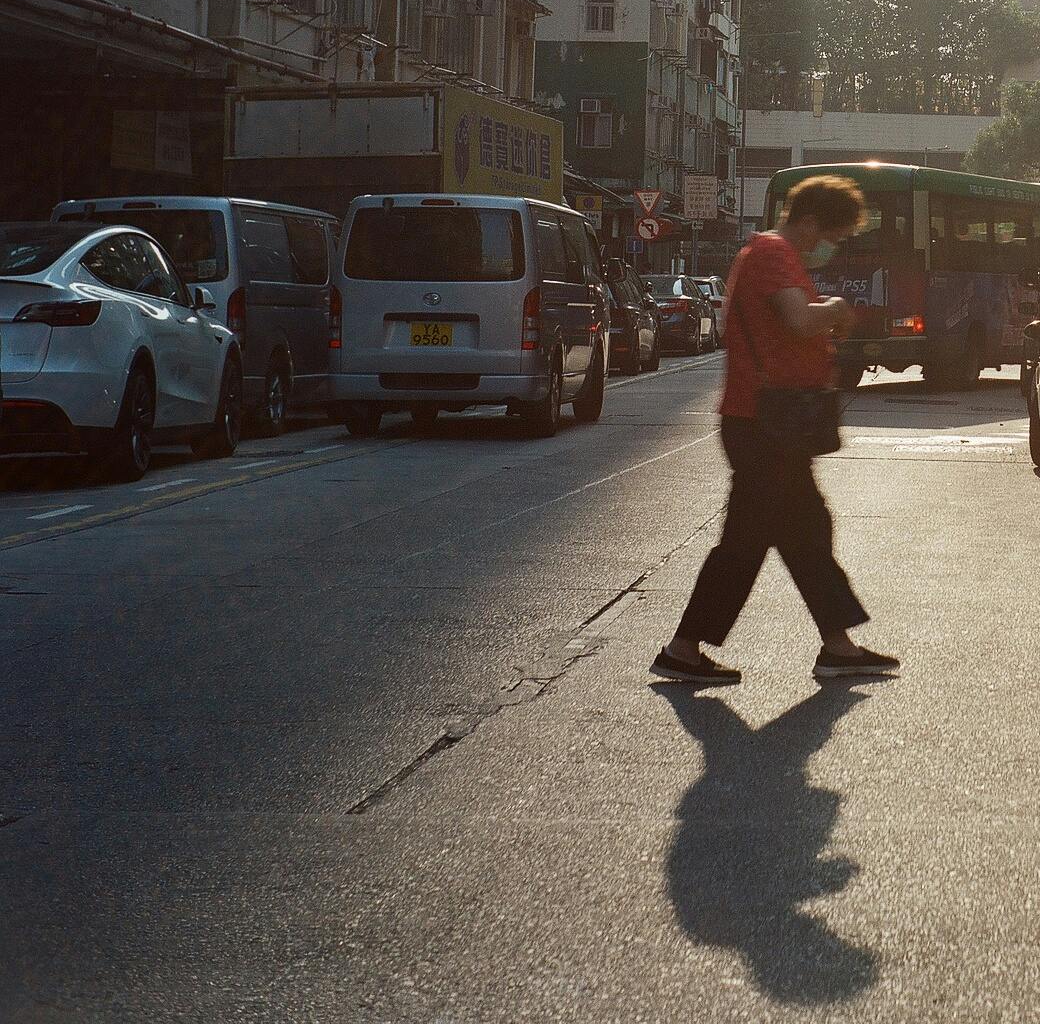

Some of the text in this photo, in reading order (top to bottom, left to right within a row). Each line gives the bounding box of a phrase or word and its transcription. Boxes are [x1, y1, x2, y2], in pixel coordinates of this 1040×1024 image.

[842, 279, 868, 292] PS5
[424, 323, 440, 334] YA
[413, 334, 449, 345] 9560
